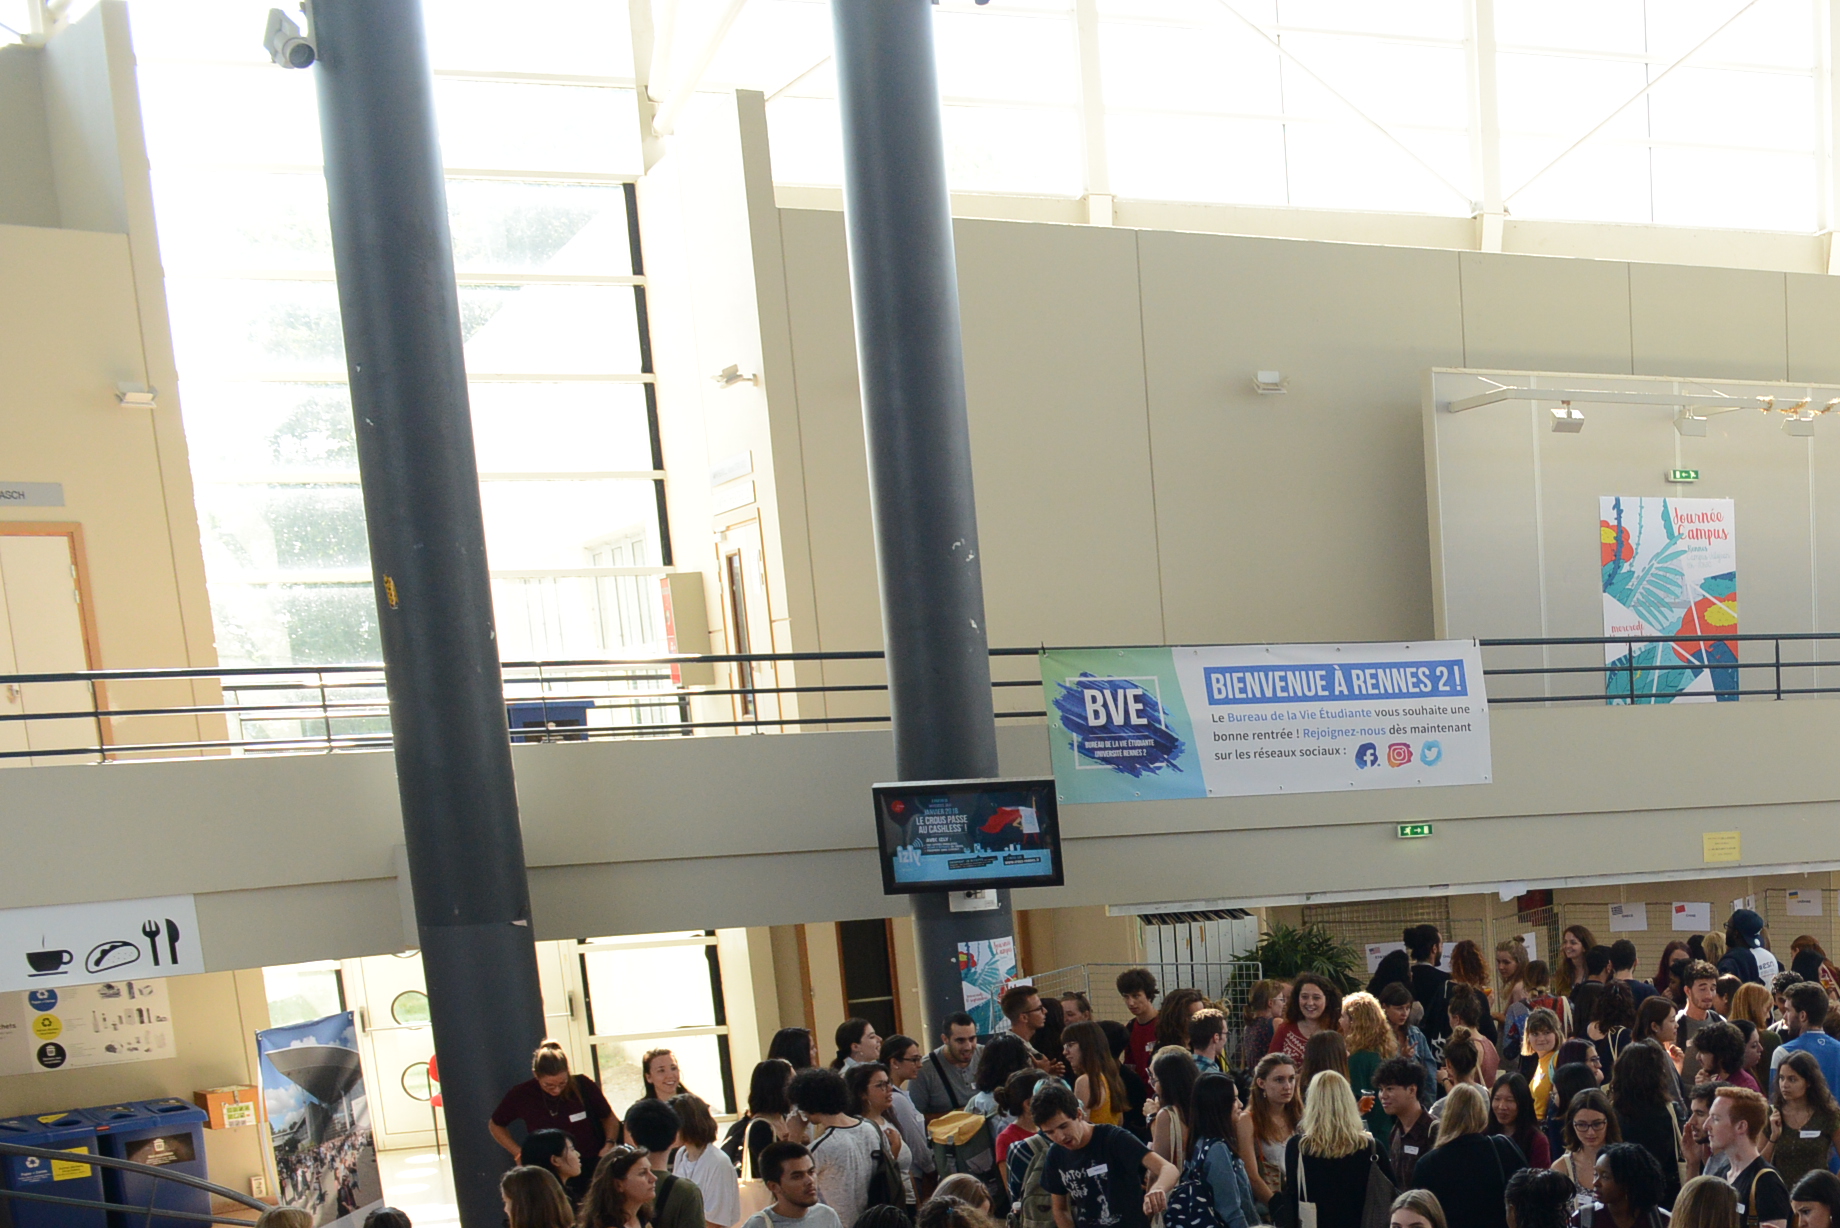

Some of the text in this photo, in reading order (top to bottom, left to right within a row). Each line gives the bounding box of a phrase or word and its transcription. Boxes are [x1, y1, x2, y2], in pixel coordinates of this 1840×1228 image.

[1673, 507, 1724, 525] Journée
[1678, 524, 1729, 546] Campus
[1210, 664, 1462, 699] BIENVENUE À RENNES 2 !
[1084, 688, 1148, 727] BVE
[1211, 705, 1470, 723] Le Bureau de la Vie Étudiante vous souhaite une
[1213, 731, 1249, 741] bonne
[1252, 728, 1293, 740] rentrée
[1303, 727, 1386, 740] Rejoignez-nous
[1389, 723, 1407, 735] dès
[1410, 722, 1472, 734] maintenant
[1214, 752, 1232, 760] sur
[1235, 749, 1251, 760] les
[1253, 747, 1297, 759] réseaux
[1299, 746, 1340, 757] sociaux
[916, 815, 968, 825] LE CROUS PASSE
[919, 826, 927, 834] AU
